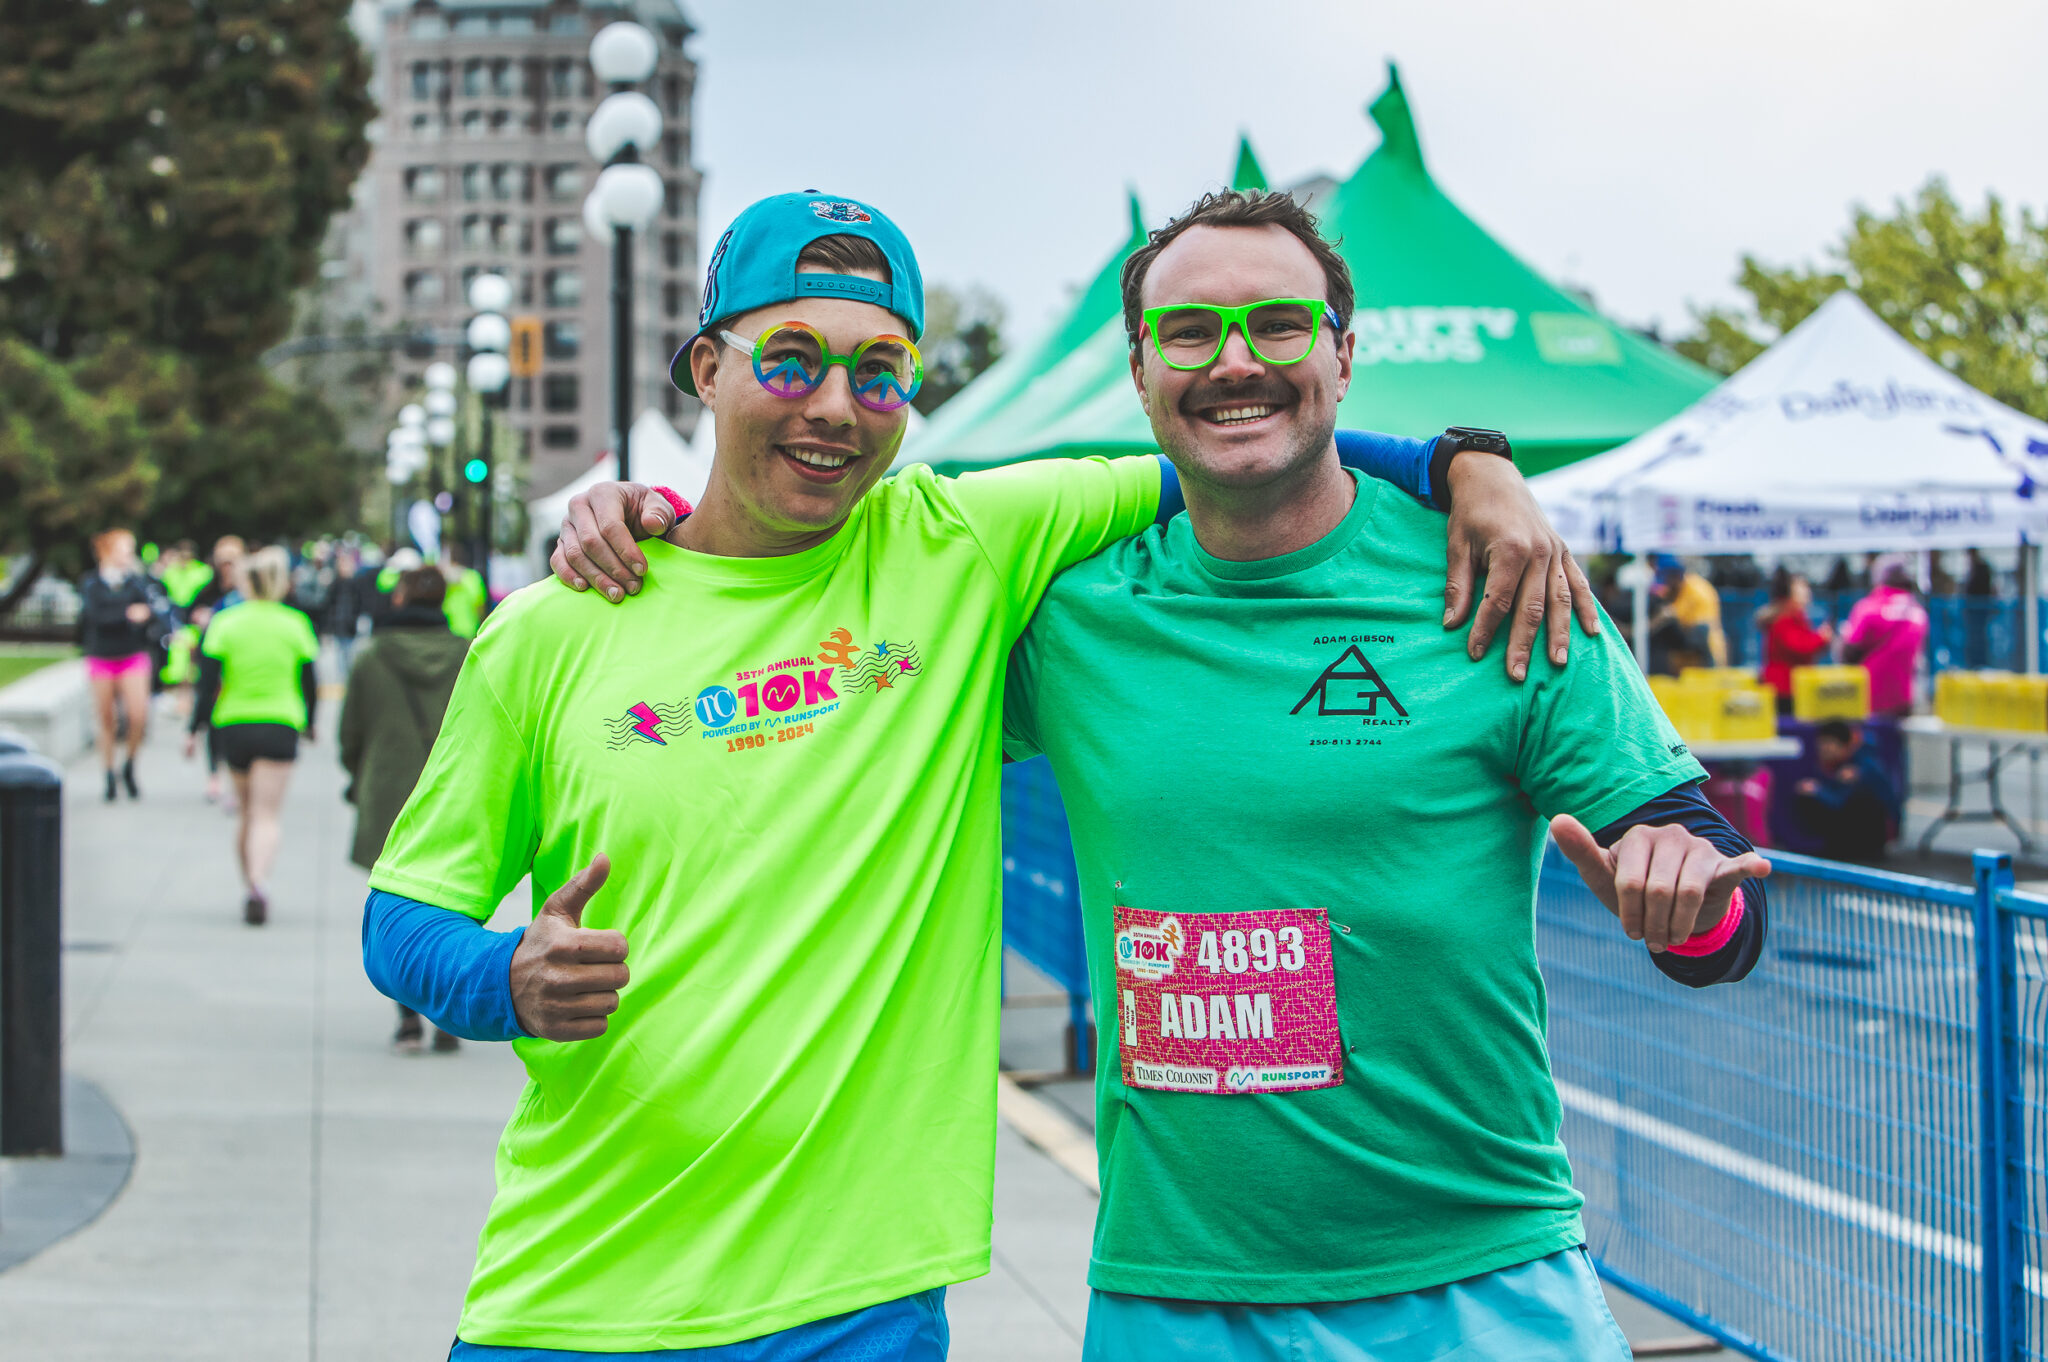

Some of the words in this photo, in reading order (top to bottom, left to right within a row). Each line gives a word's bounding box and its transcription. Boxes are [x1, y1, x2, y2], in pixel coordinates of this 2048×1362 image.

[1312, 635, 1347, 645] ADAM
[1350, 634, 1395, 644] GIBSON
[735, 667, 765, 681] 35TH
[766, 656, 815, 673] ANNUAL
[696, 689, 737, 725] TC
[737, 667, 839, 718] 10K
[702, 722, 747, 739] POWERED
[748, 719, 762, 732] BY
[783, 701, 841, 726] RUNSPORT
[1362, 718, 1412, 726] REALTY
[726, 733, 765, 752] 1990
[776, 722, 814, 744] 2024
[1355, 738, 1382, 746] 2744
[1133, 939, 1170, 962] 10K
[1197, 925, 1306, 975] 4893
[1160, 992, 1275, 1040] ADAM
[1136, 1065, 1164, 1082] TIMES
[1165, 1068, 1214, 1086] COLONIST
[1261, 1069, 1327, 1083] RUNSPORT
